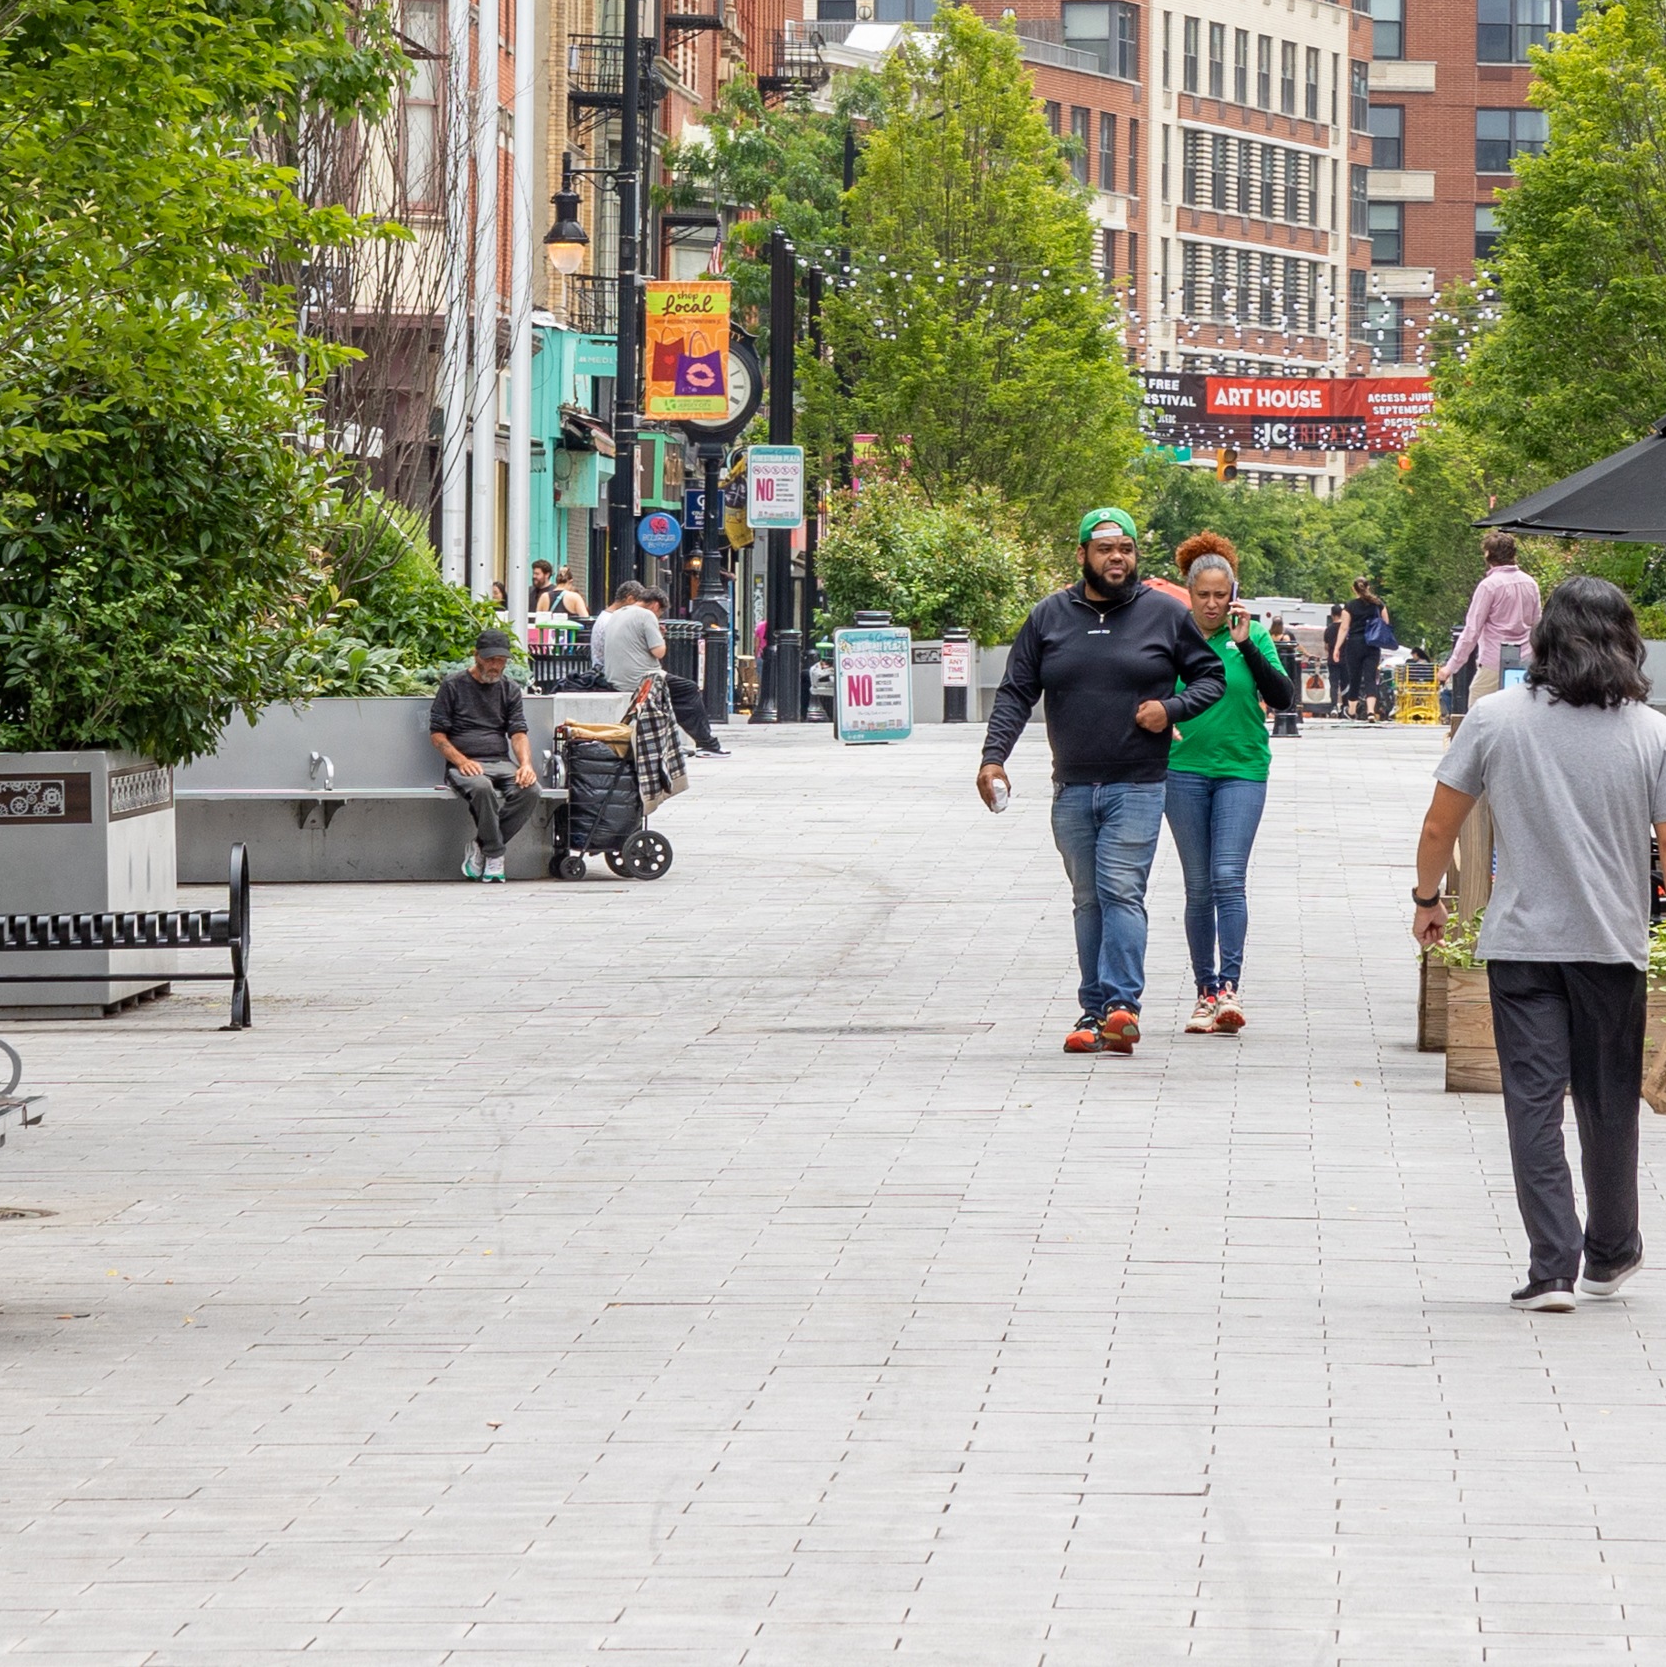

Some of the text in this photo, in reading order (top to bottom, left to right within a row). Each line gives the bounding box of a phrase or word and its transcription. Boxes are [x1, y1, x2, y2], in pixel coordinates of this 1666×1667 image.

[677, 291, 699, 302] shop
[662, 294, 714, 316] Local
[589, 356, 617, 364] MEDL
[1148, 378, 1180, 391] FREE
[1144, 393, 1197, 407] ESTIVAL
[1214, 387, 1323, 409] ART HOUSE
[1367, 392, 1434, 403] ACCESS JUNE
[1372, 404, 1431, 415] SEPTEMBER
[1259, 423, 1288, 445] JC
[756, 478, 775, 502] NO
[847, 674, 873, 707] NO
